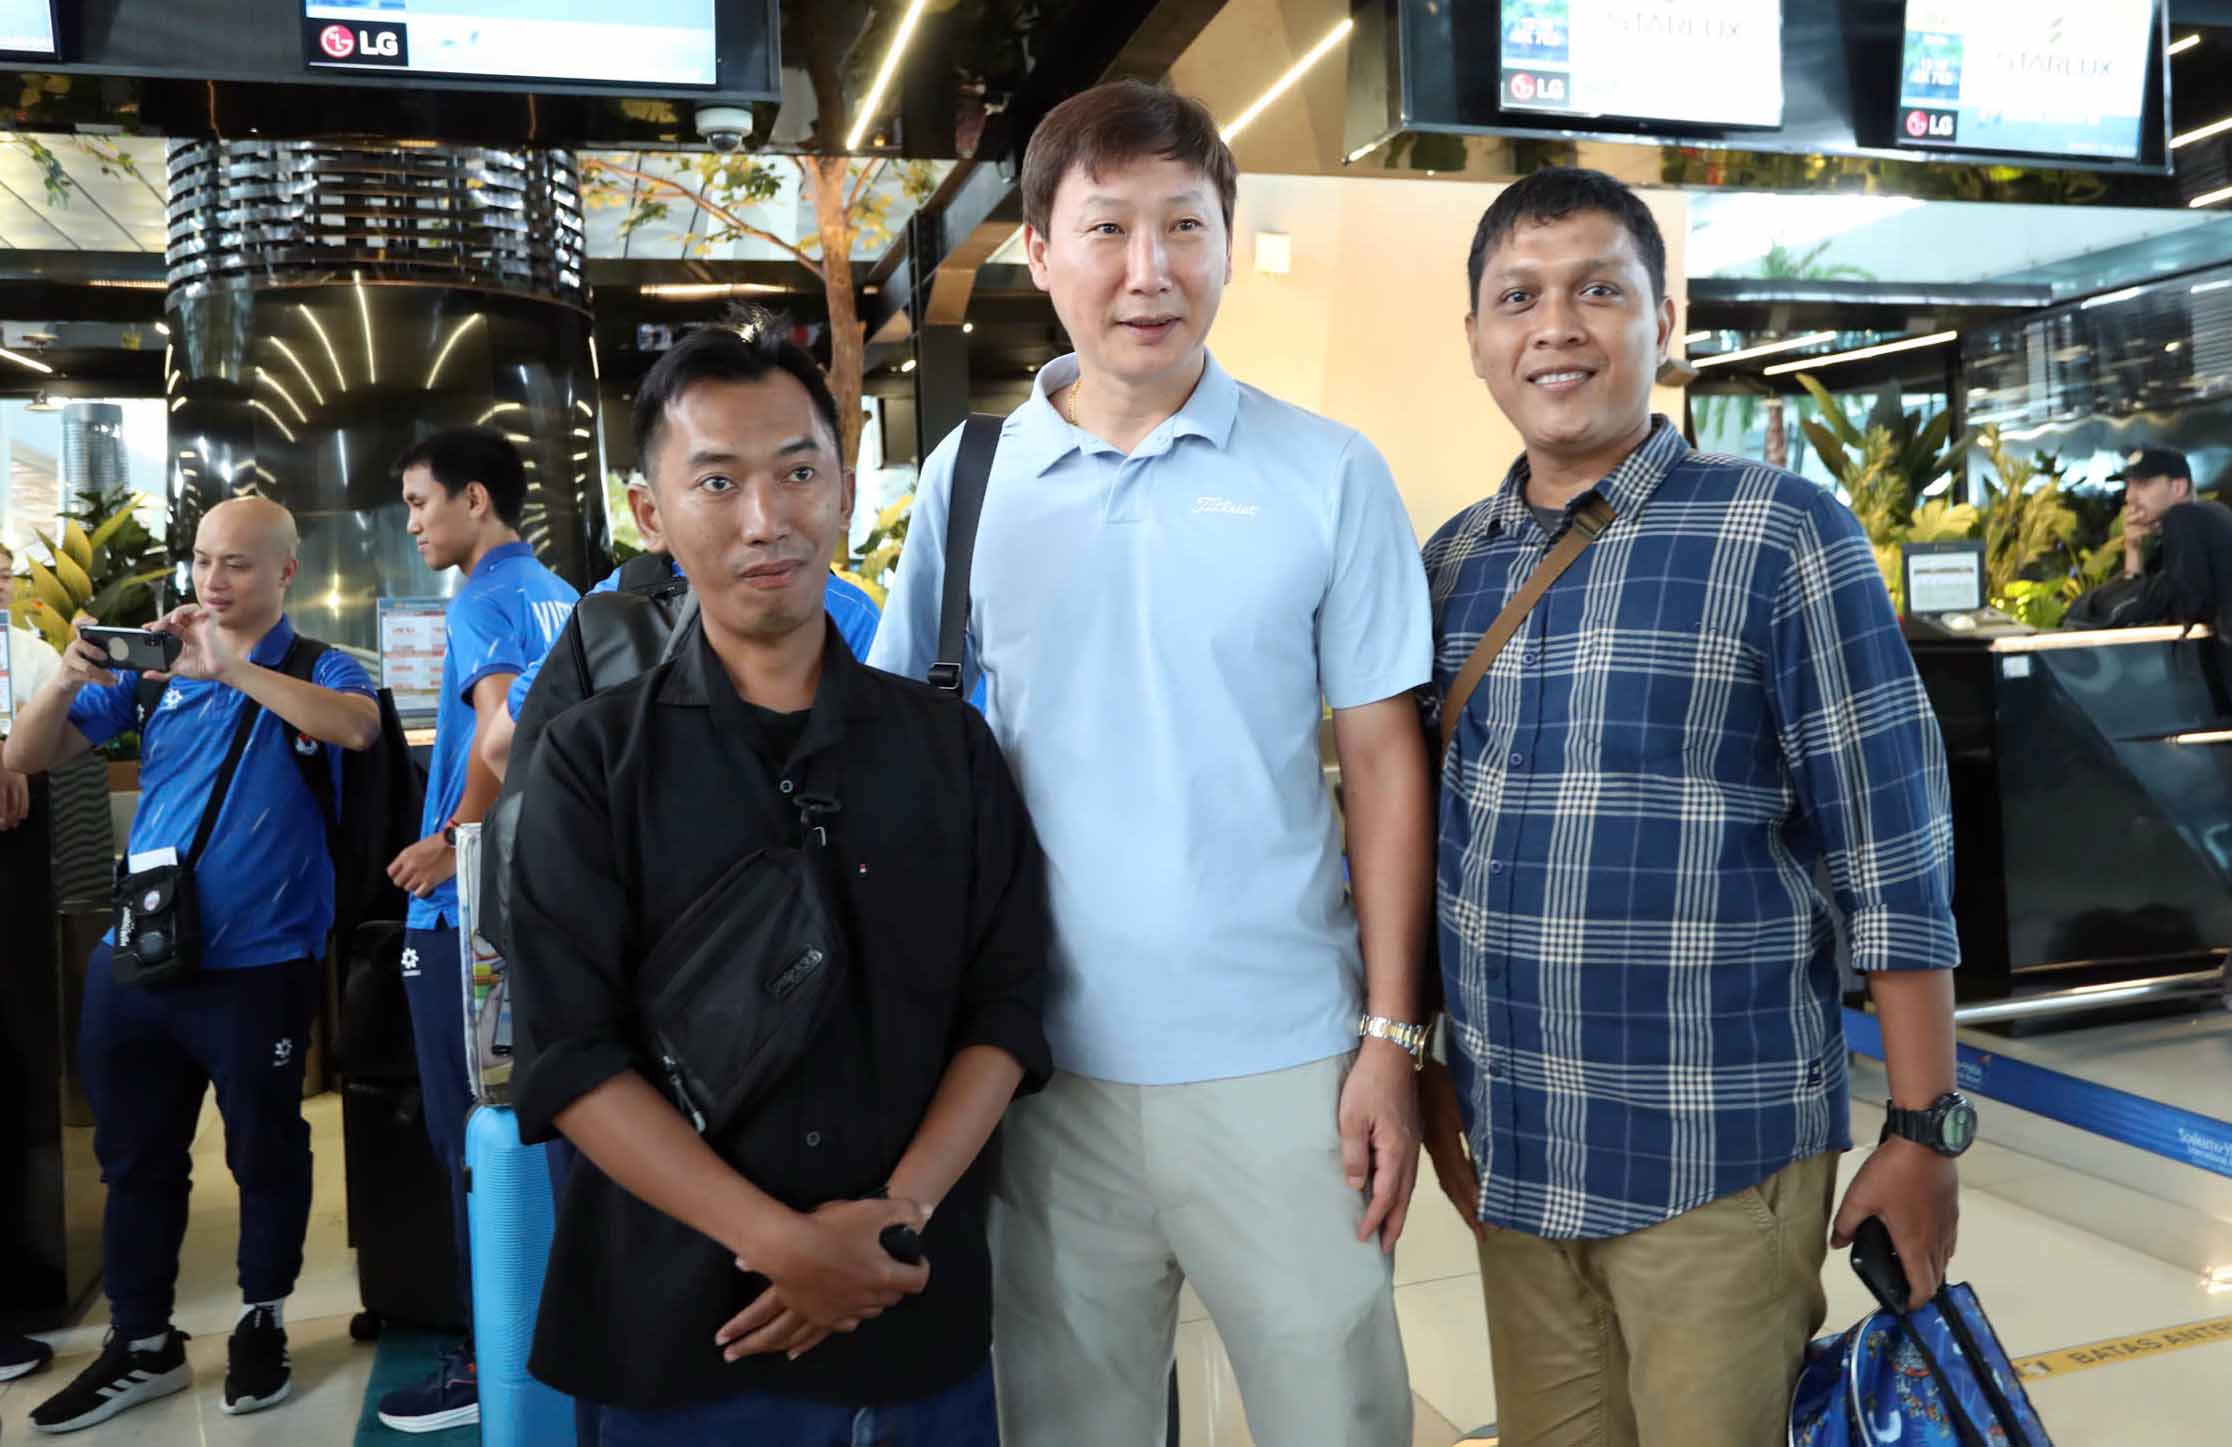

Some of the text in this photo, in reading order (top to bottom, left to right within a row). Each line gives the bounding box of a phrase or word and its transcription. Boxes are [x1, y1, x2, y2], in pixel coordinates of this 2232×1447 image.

[359, 30, 399, 57] LG
[1536, 77, 1565, 100] LG
[1928, 114, 1954, 136] LG
[2069, 1339, 2162, 1364] BATAS
